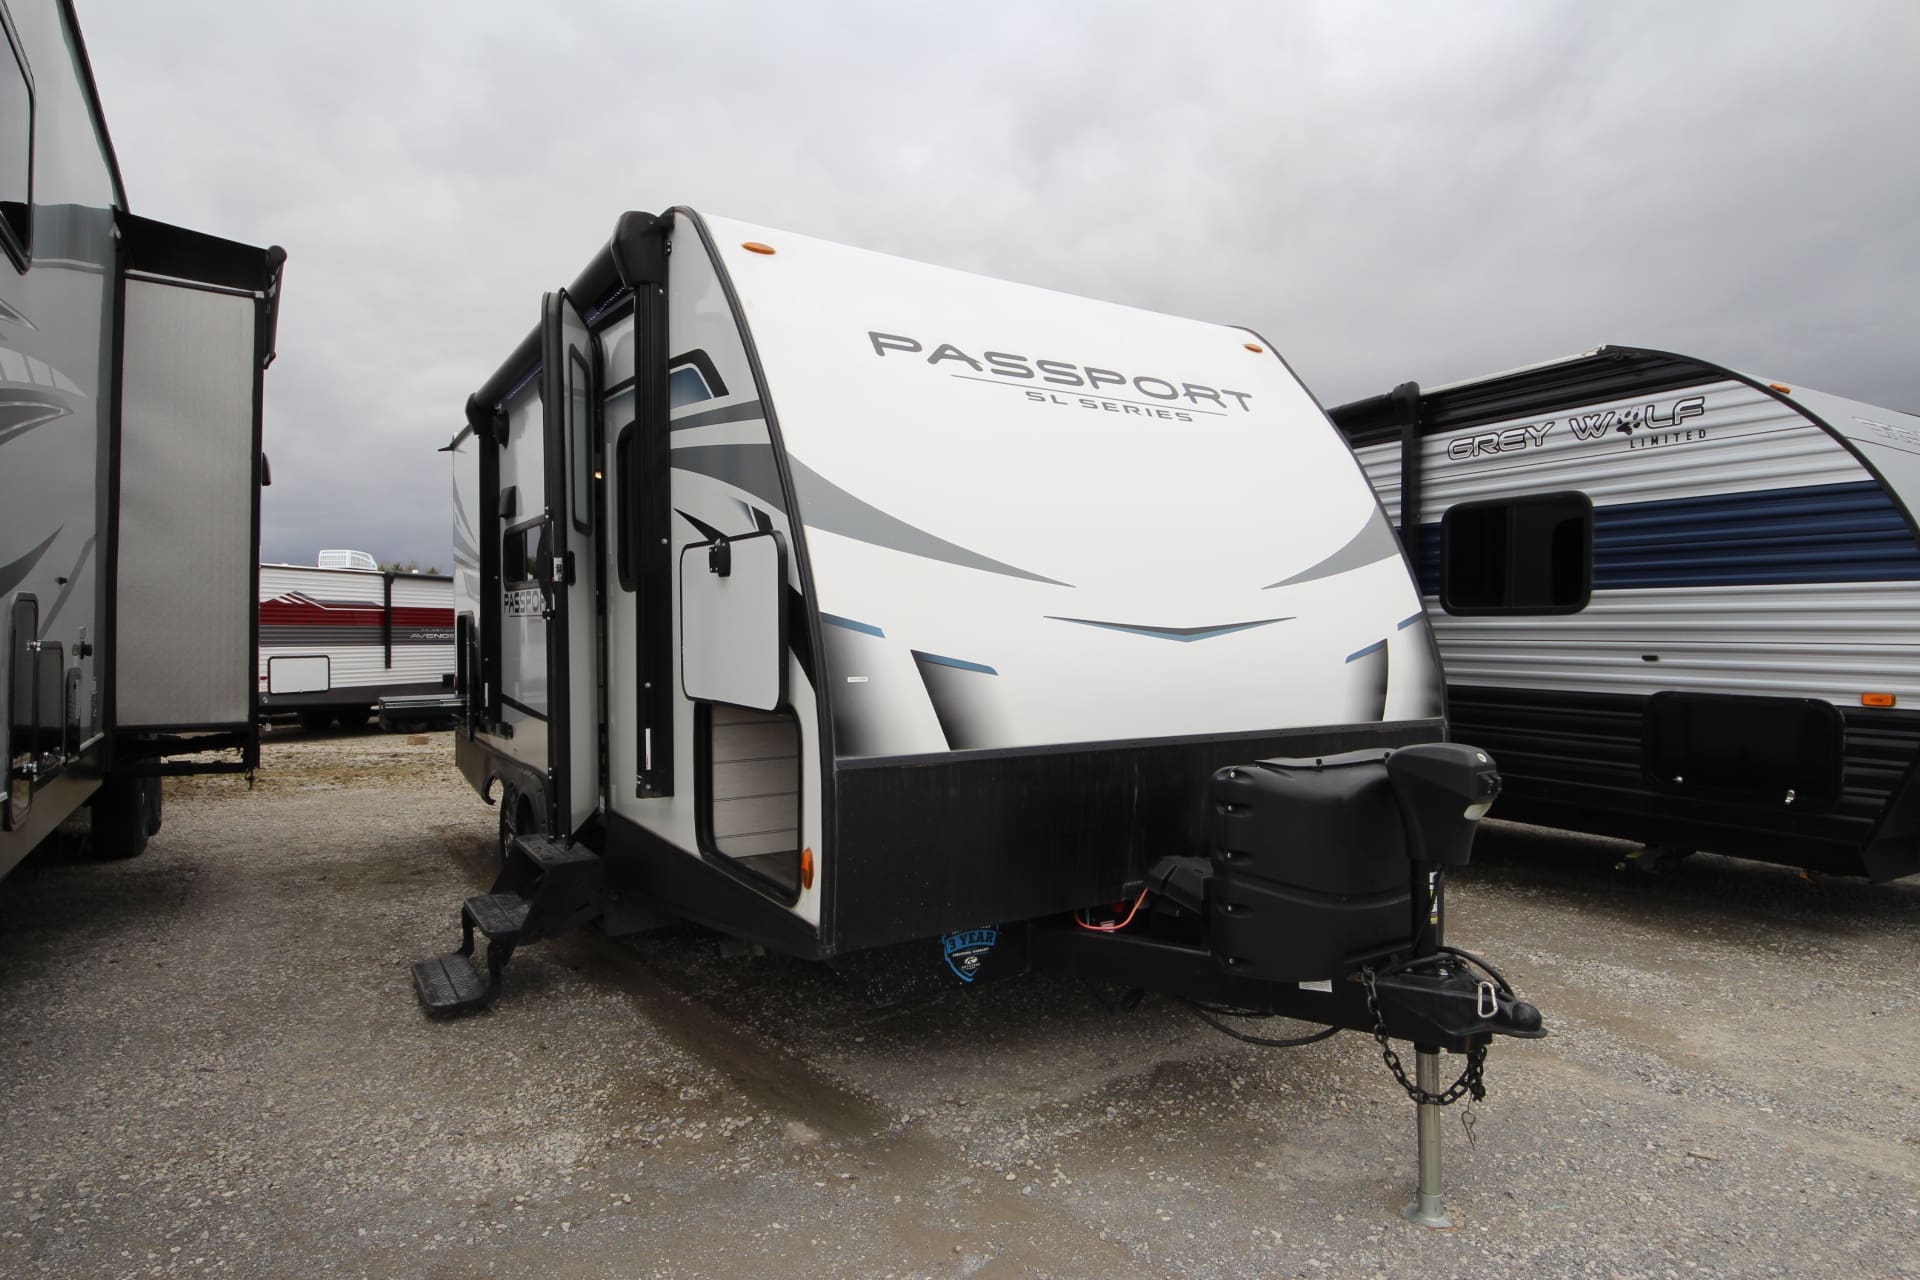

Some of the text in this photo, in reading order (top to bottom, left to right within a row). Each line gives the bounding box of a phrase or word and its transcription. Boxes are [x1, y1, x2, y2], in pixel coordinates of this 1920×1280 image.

[868, 331, 1252, 412] PASSPORT
[1025, 391, 1193, 422] SL SERIES
[1448, 422, 1555, 460] GREY
[1630, 429, 1706, 449] LIMITED
[959, 931, 994, 946] YEAR
